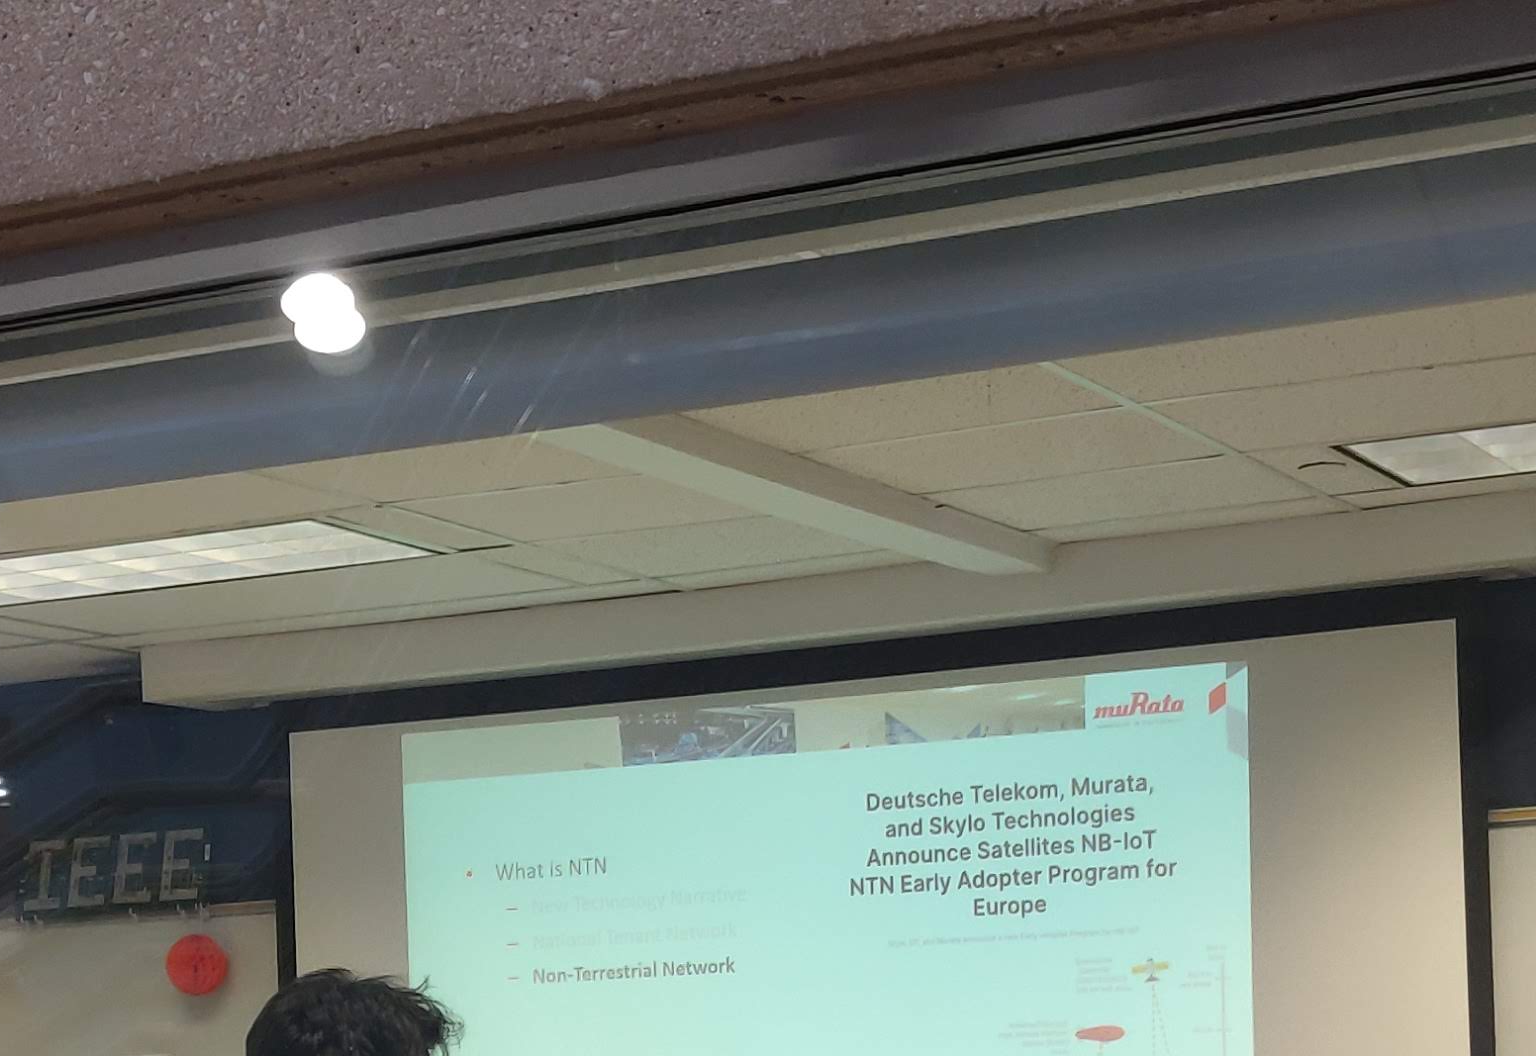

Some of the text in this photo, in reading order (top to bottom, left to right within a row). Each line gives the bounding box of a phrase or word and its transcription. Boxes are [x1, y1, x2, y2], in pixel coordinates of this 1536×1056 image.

[866, 775, 1154, 811] Deutsche Telekom, Murata,
[885, 803, 1136, 838] and Skylo Technologies
[866, 829, 1157, 867] Announce Satellites NB-IoT
[23, 827, 205, 912] IEEE
[496, 857, 608, 881] What is NTN
[850, 858, 1178, 897] NTN Early Adopter Program for
[973, 896, 1047, 919] Europe
[532, 956, 736, 984] Non-Terrestrial Network
